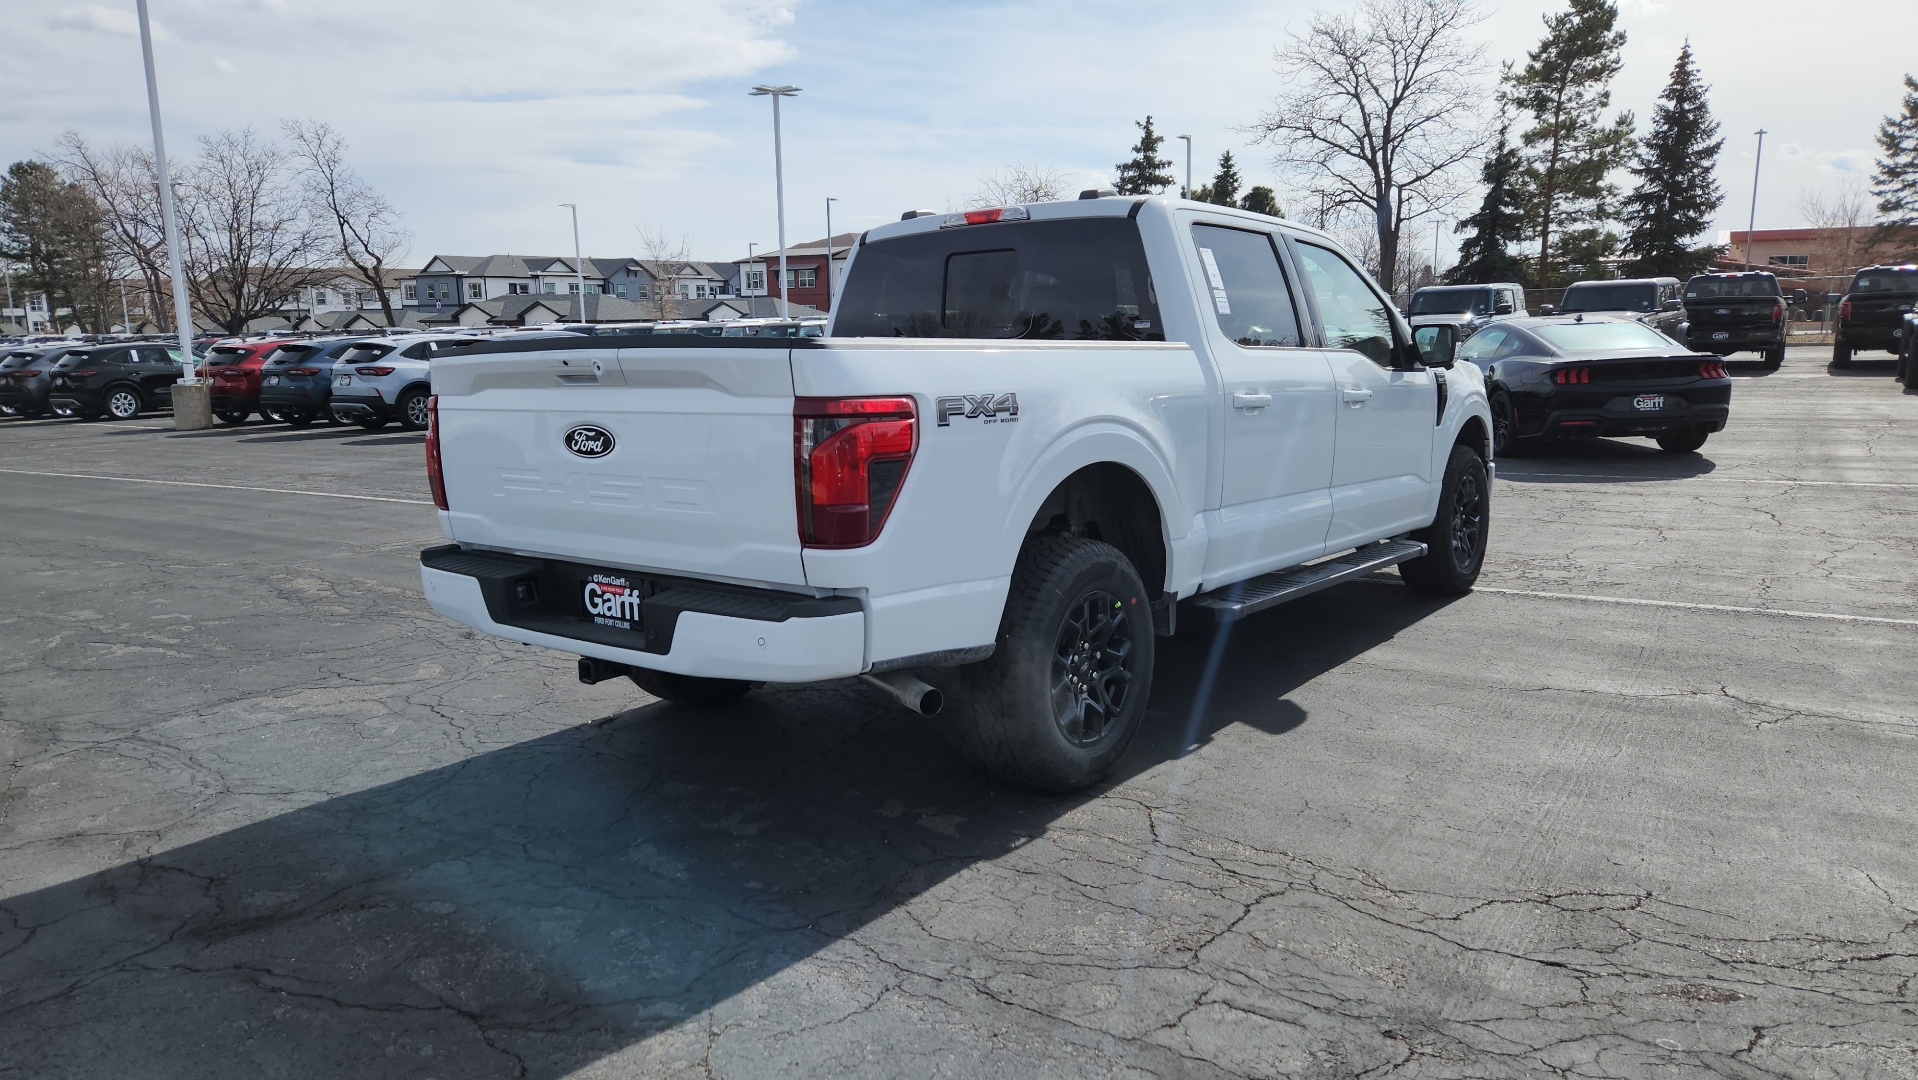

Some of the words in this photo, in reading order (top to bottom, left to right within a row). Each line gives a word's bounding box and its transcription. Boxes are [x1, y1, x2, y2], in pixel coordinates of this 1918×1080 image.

[935, 393, 1018, 427] FX4
[1633, 396, 1664, 408] Garff
[572, 430, 604, 452] Ford
[584, 582, 640, 621] Garff
[594, 616, 604, 625] FORD
[605, 618, 614, 627] FORT
[615, 619, 630, 630] COLLINS
